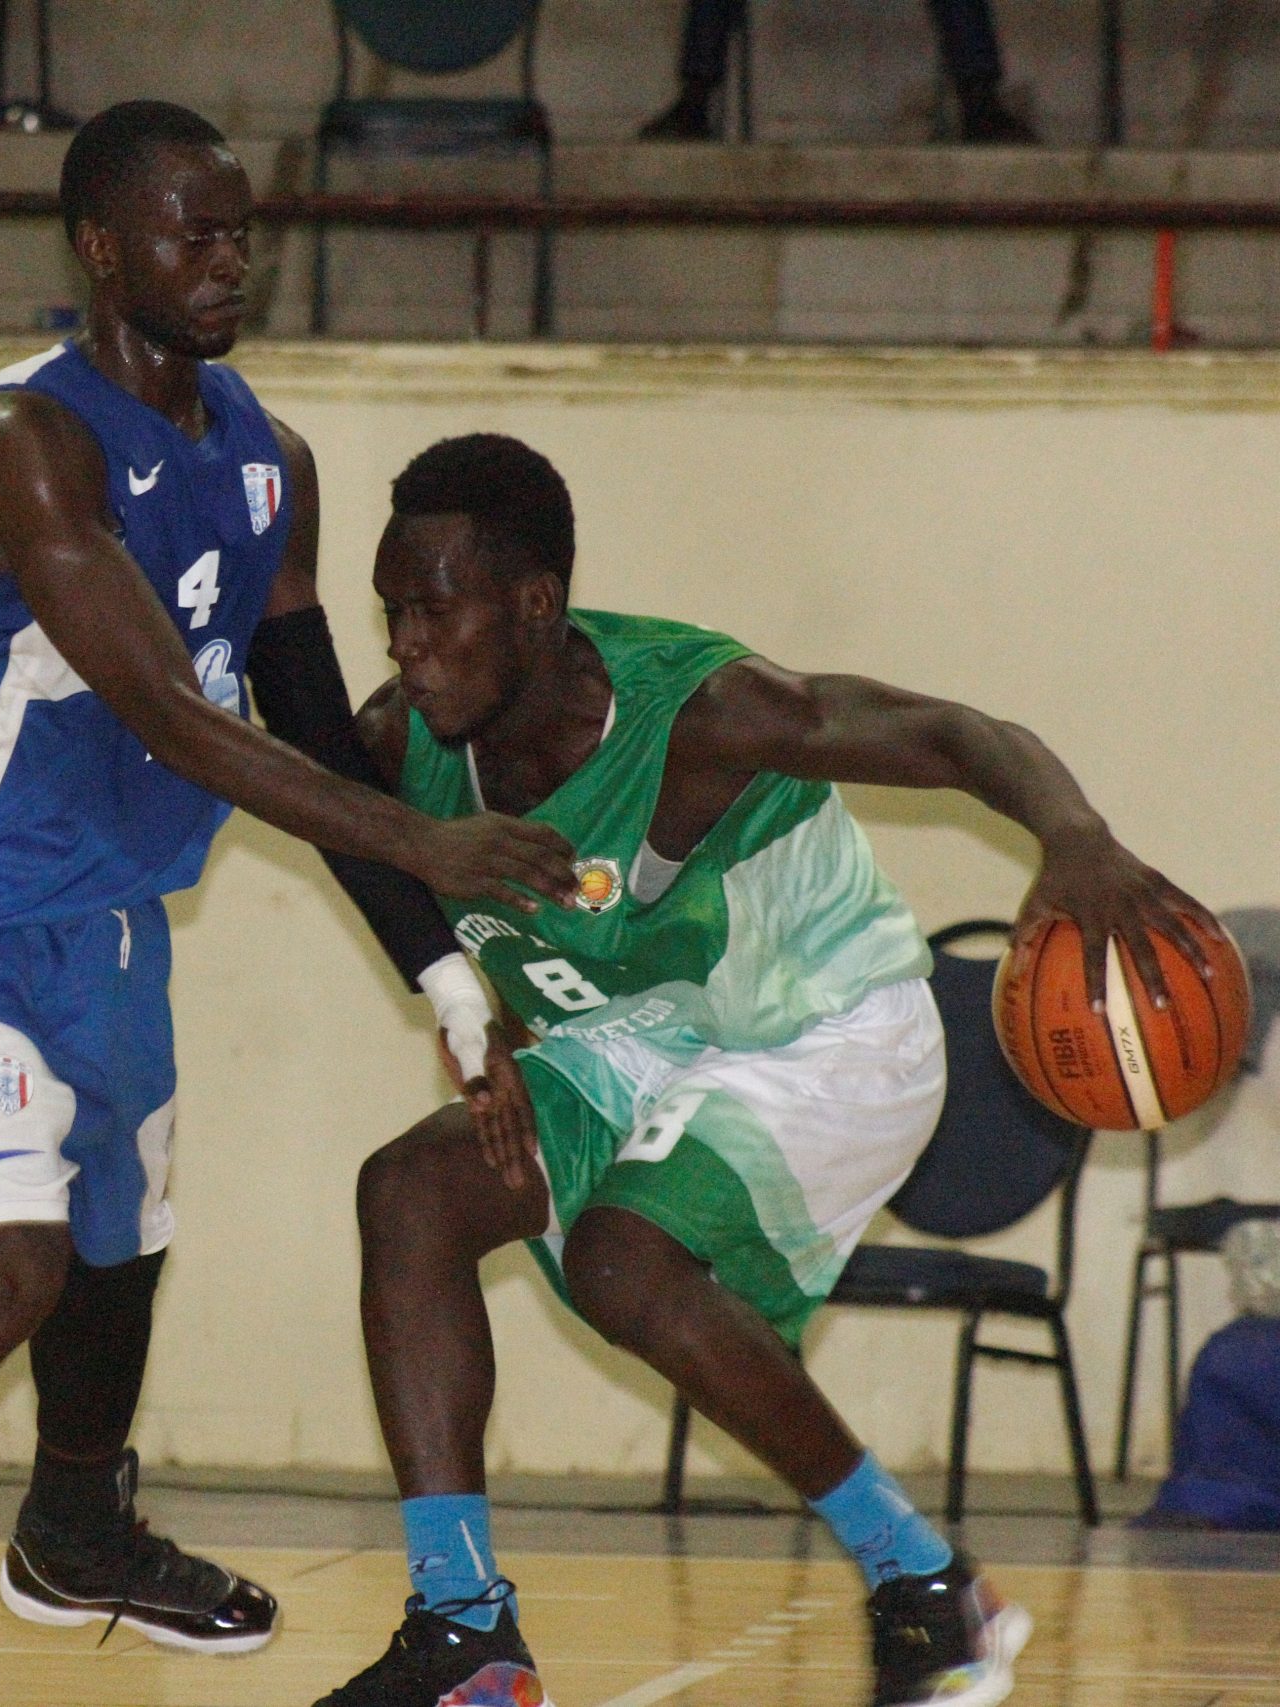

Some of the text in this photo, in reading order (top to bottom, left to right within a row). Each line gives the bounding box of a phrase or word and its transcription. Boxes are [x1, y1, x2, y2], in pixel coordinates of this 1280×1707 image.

[178, 549, 221, 630] 4
[522, 958, 609, 1012] 8
[1049, 1027, 1081, 1080] FIBA
[1117, 1025, 1140, 1074] GM7X
